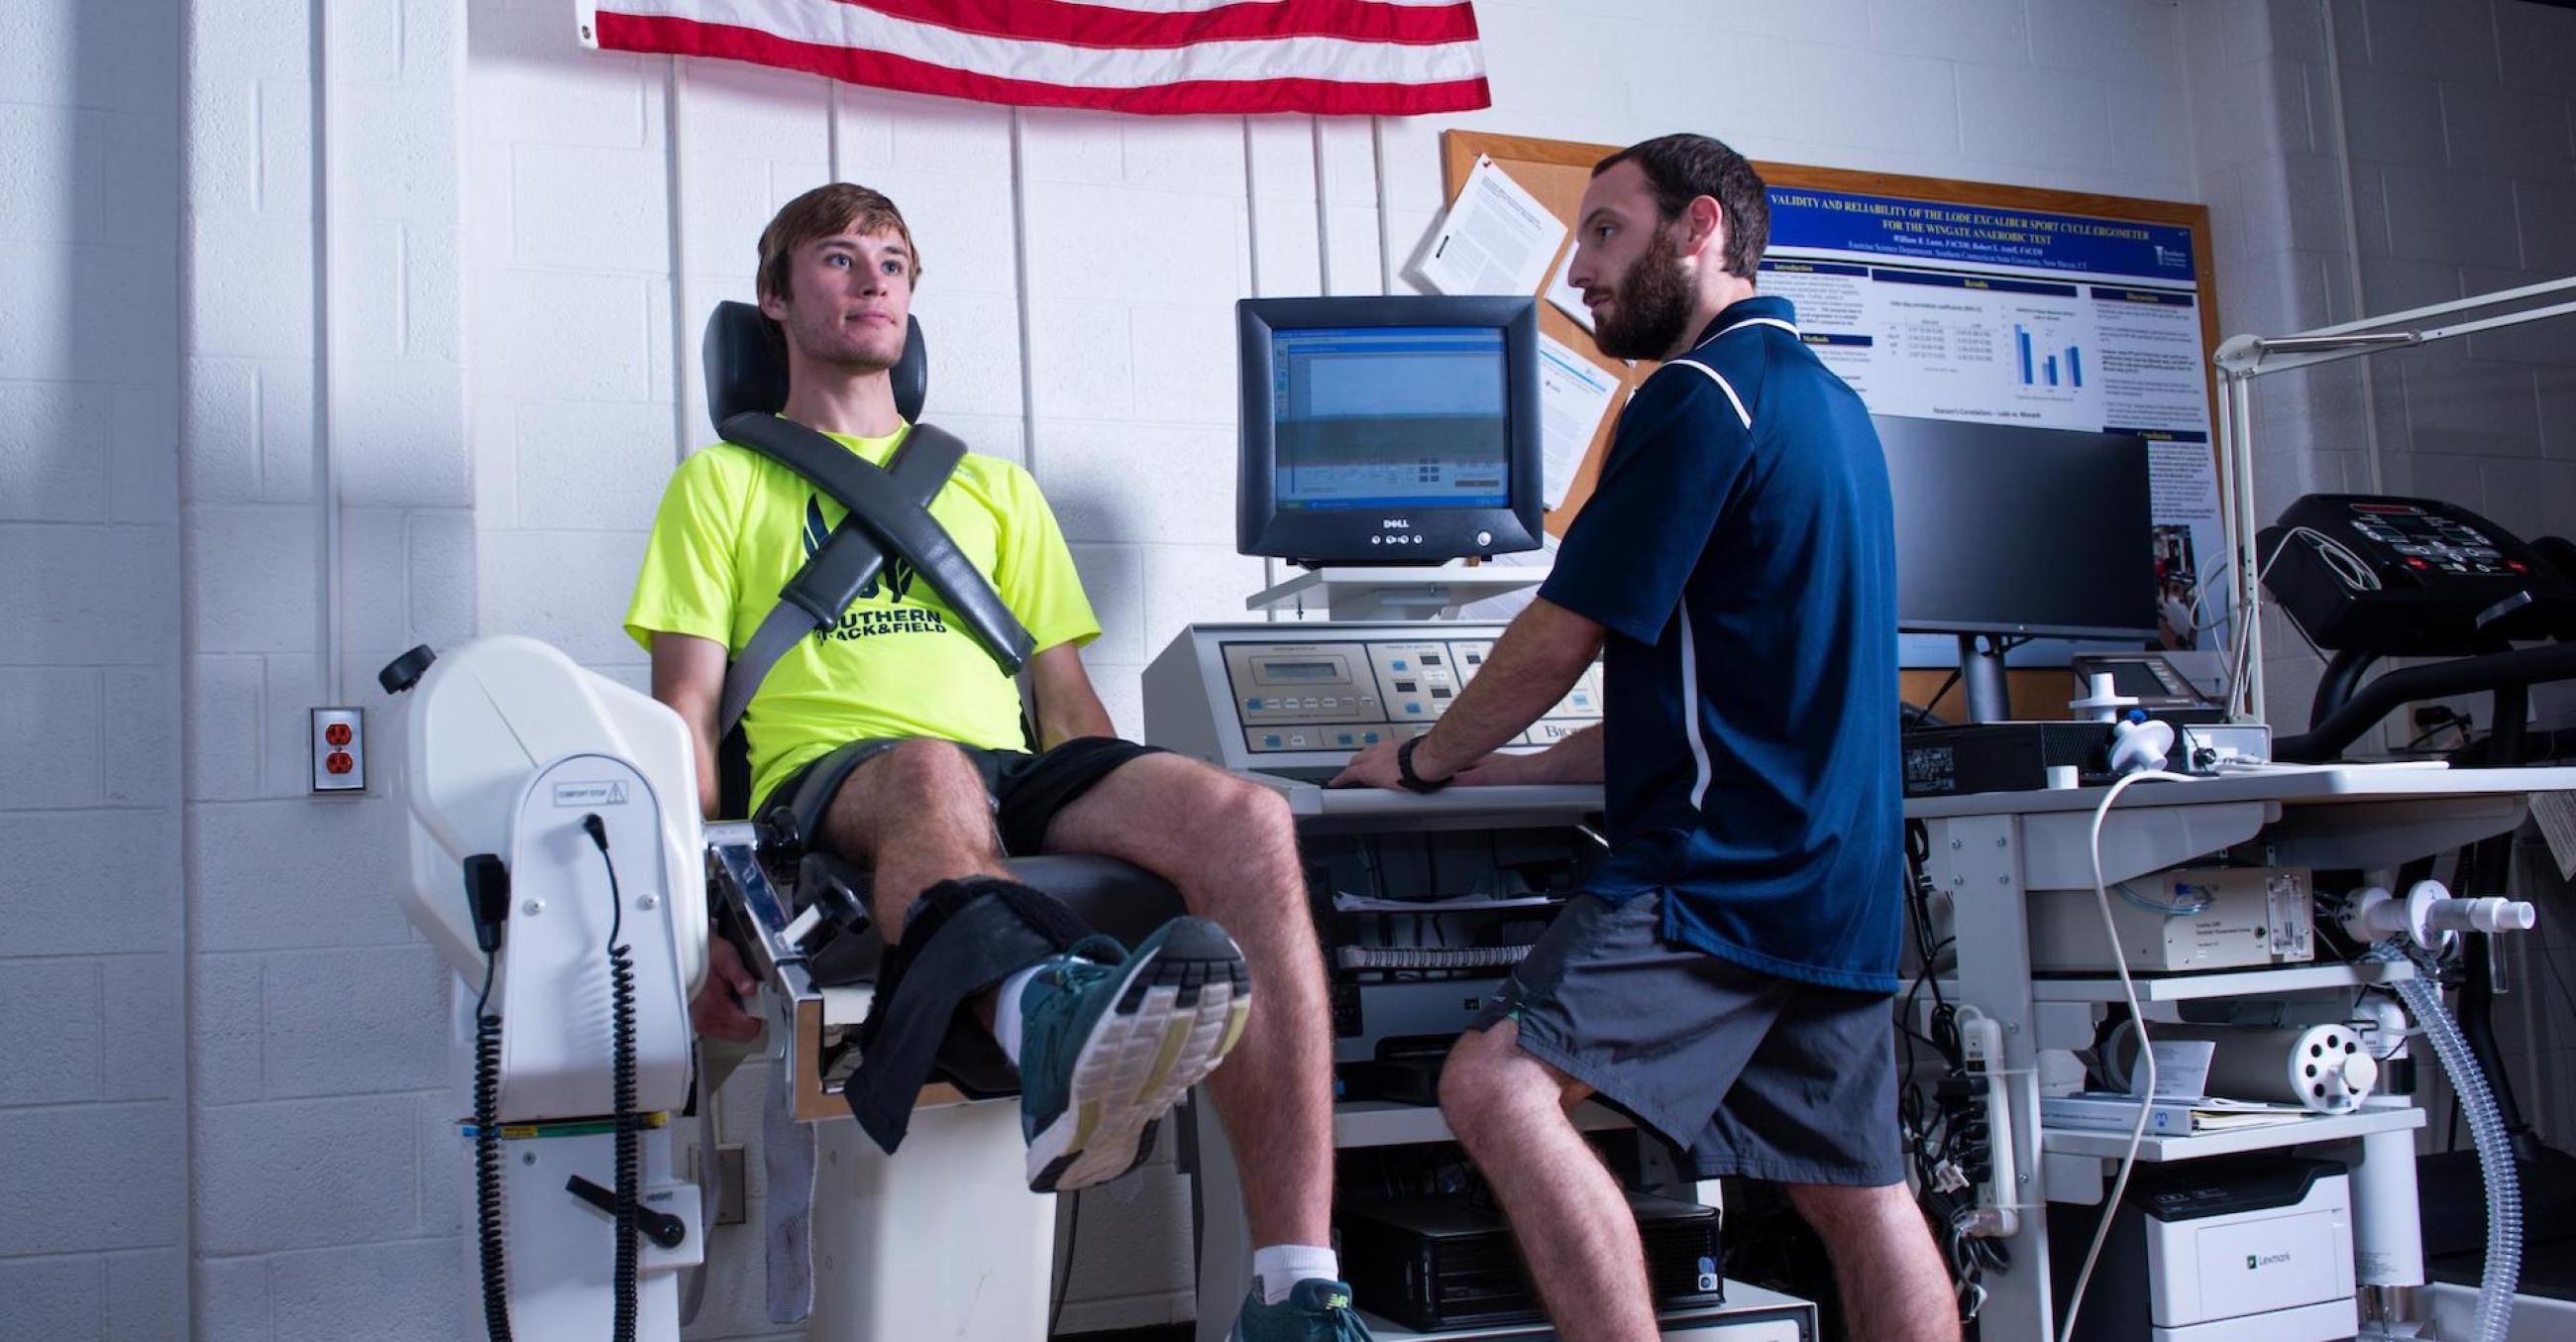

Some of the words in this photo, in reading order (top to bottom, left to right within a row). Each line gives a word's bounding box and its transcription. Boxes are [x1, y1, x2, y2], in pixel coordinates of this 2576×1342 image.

[1771, 194, 1820, 209] VALIDITY
[1821, 199, 1843, 211] AND
[1844, 201, 1907, 217] RELIABILITY
[1908, 208, 1923, 218] OF
[1924, 209, 1944, 221] THE
[1945, 211, 1972, 224] LODE
[1973, 214, 2028, 229] EXCALIBUR
[2029, 219, 2059, 233] SPORT
[2060, 224, 2093, 236] CYCLE
[2093, 227, 2150, 240] ERGOMETER
[1882, 219, 1904, 231] FOR
[1905, 222, 1923, 234] THE
[1925, 224, 1972, 238] WINGATE
[1973, 228, 2026, 244] ANAEROBIC
[2029, 234, 2053, 246] TEST
[1964, 279, 1989, 288] Results
[1383, 519, 1409, 528] DELL
